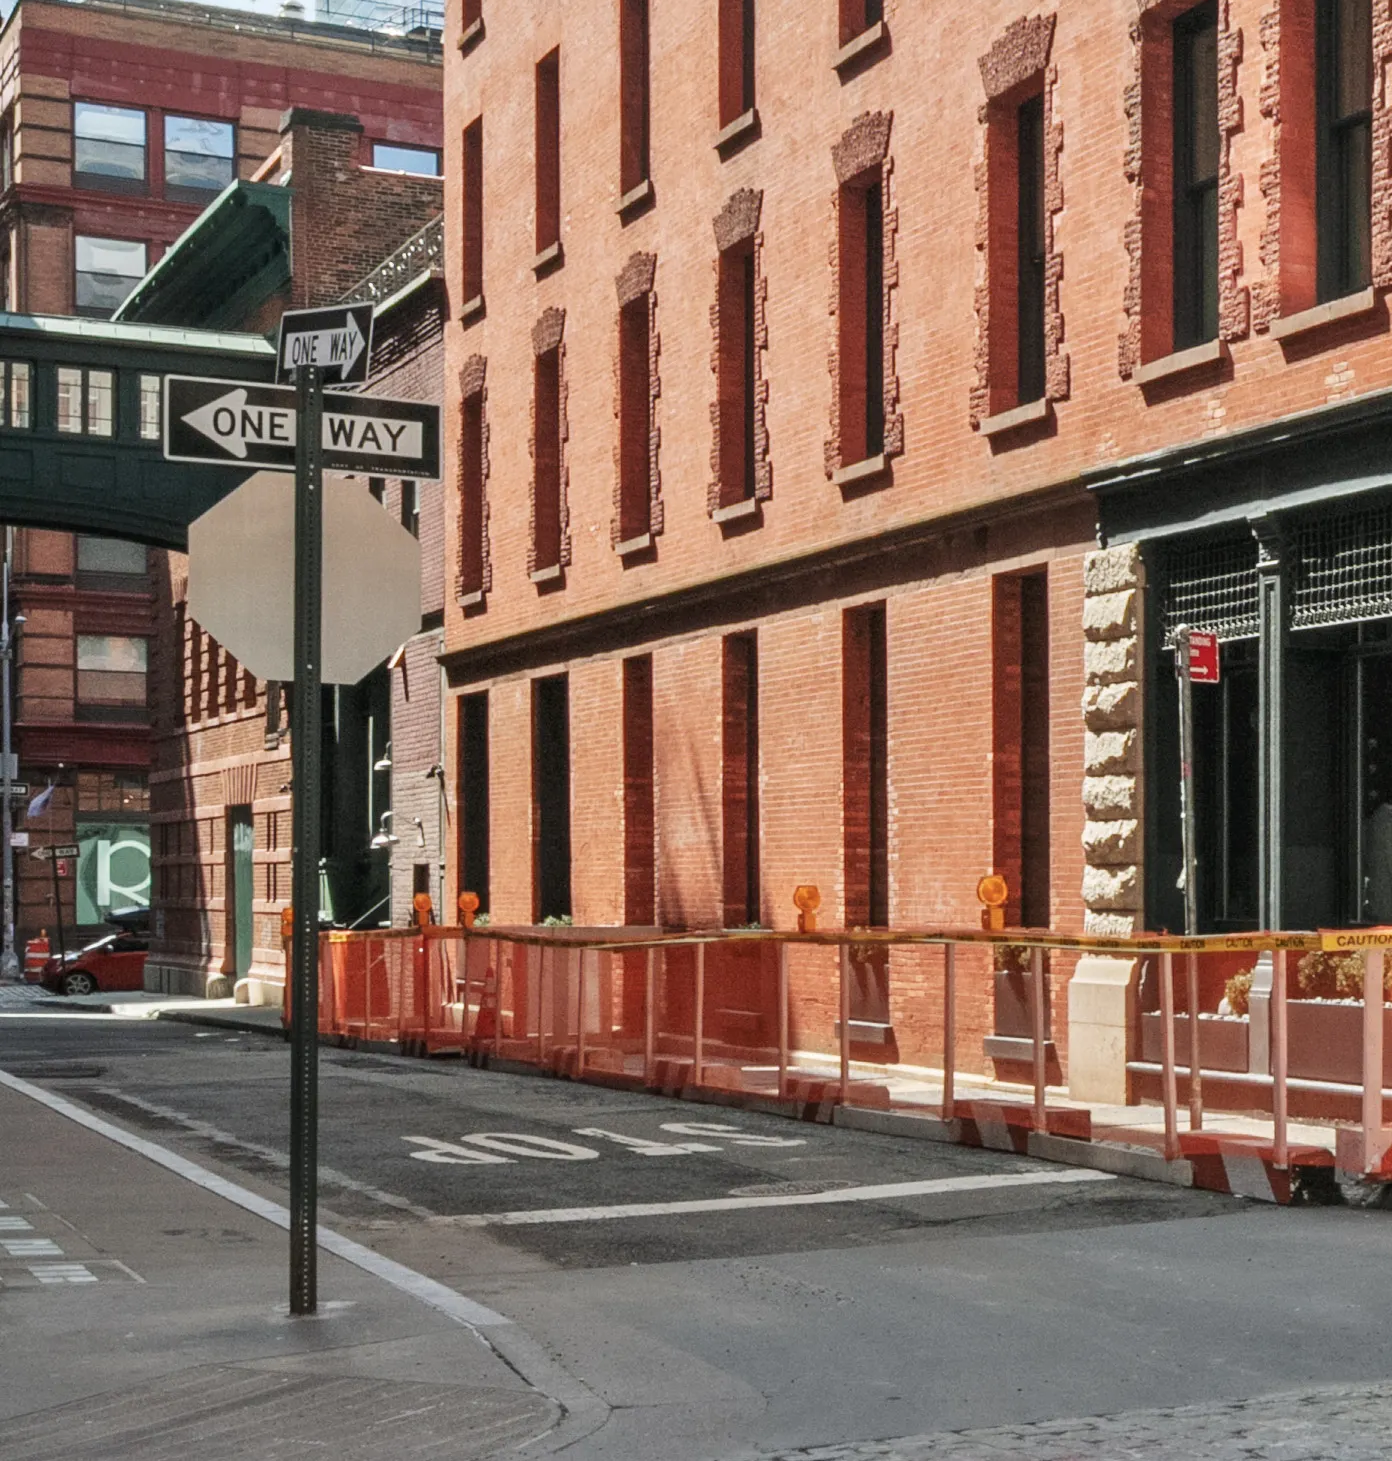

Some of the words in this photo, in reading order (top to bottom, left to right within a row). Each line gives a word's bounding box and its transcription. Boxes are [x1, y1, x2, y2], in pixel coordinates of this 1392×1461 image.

[292, 335, 319, 364] ONE
[330, 330, 357, 362] WAY
[213, 407, 289, 442] ONE
[329, 417, 406, 452] WAY
[1225, 937, 1253, 948] CAUTION
[400, 1122, 806, 1165] STOP
